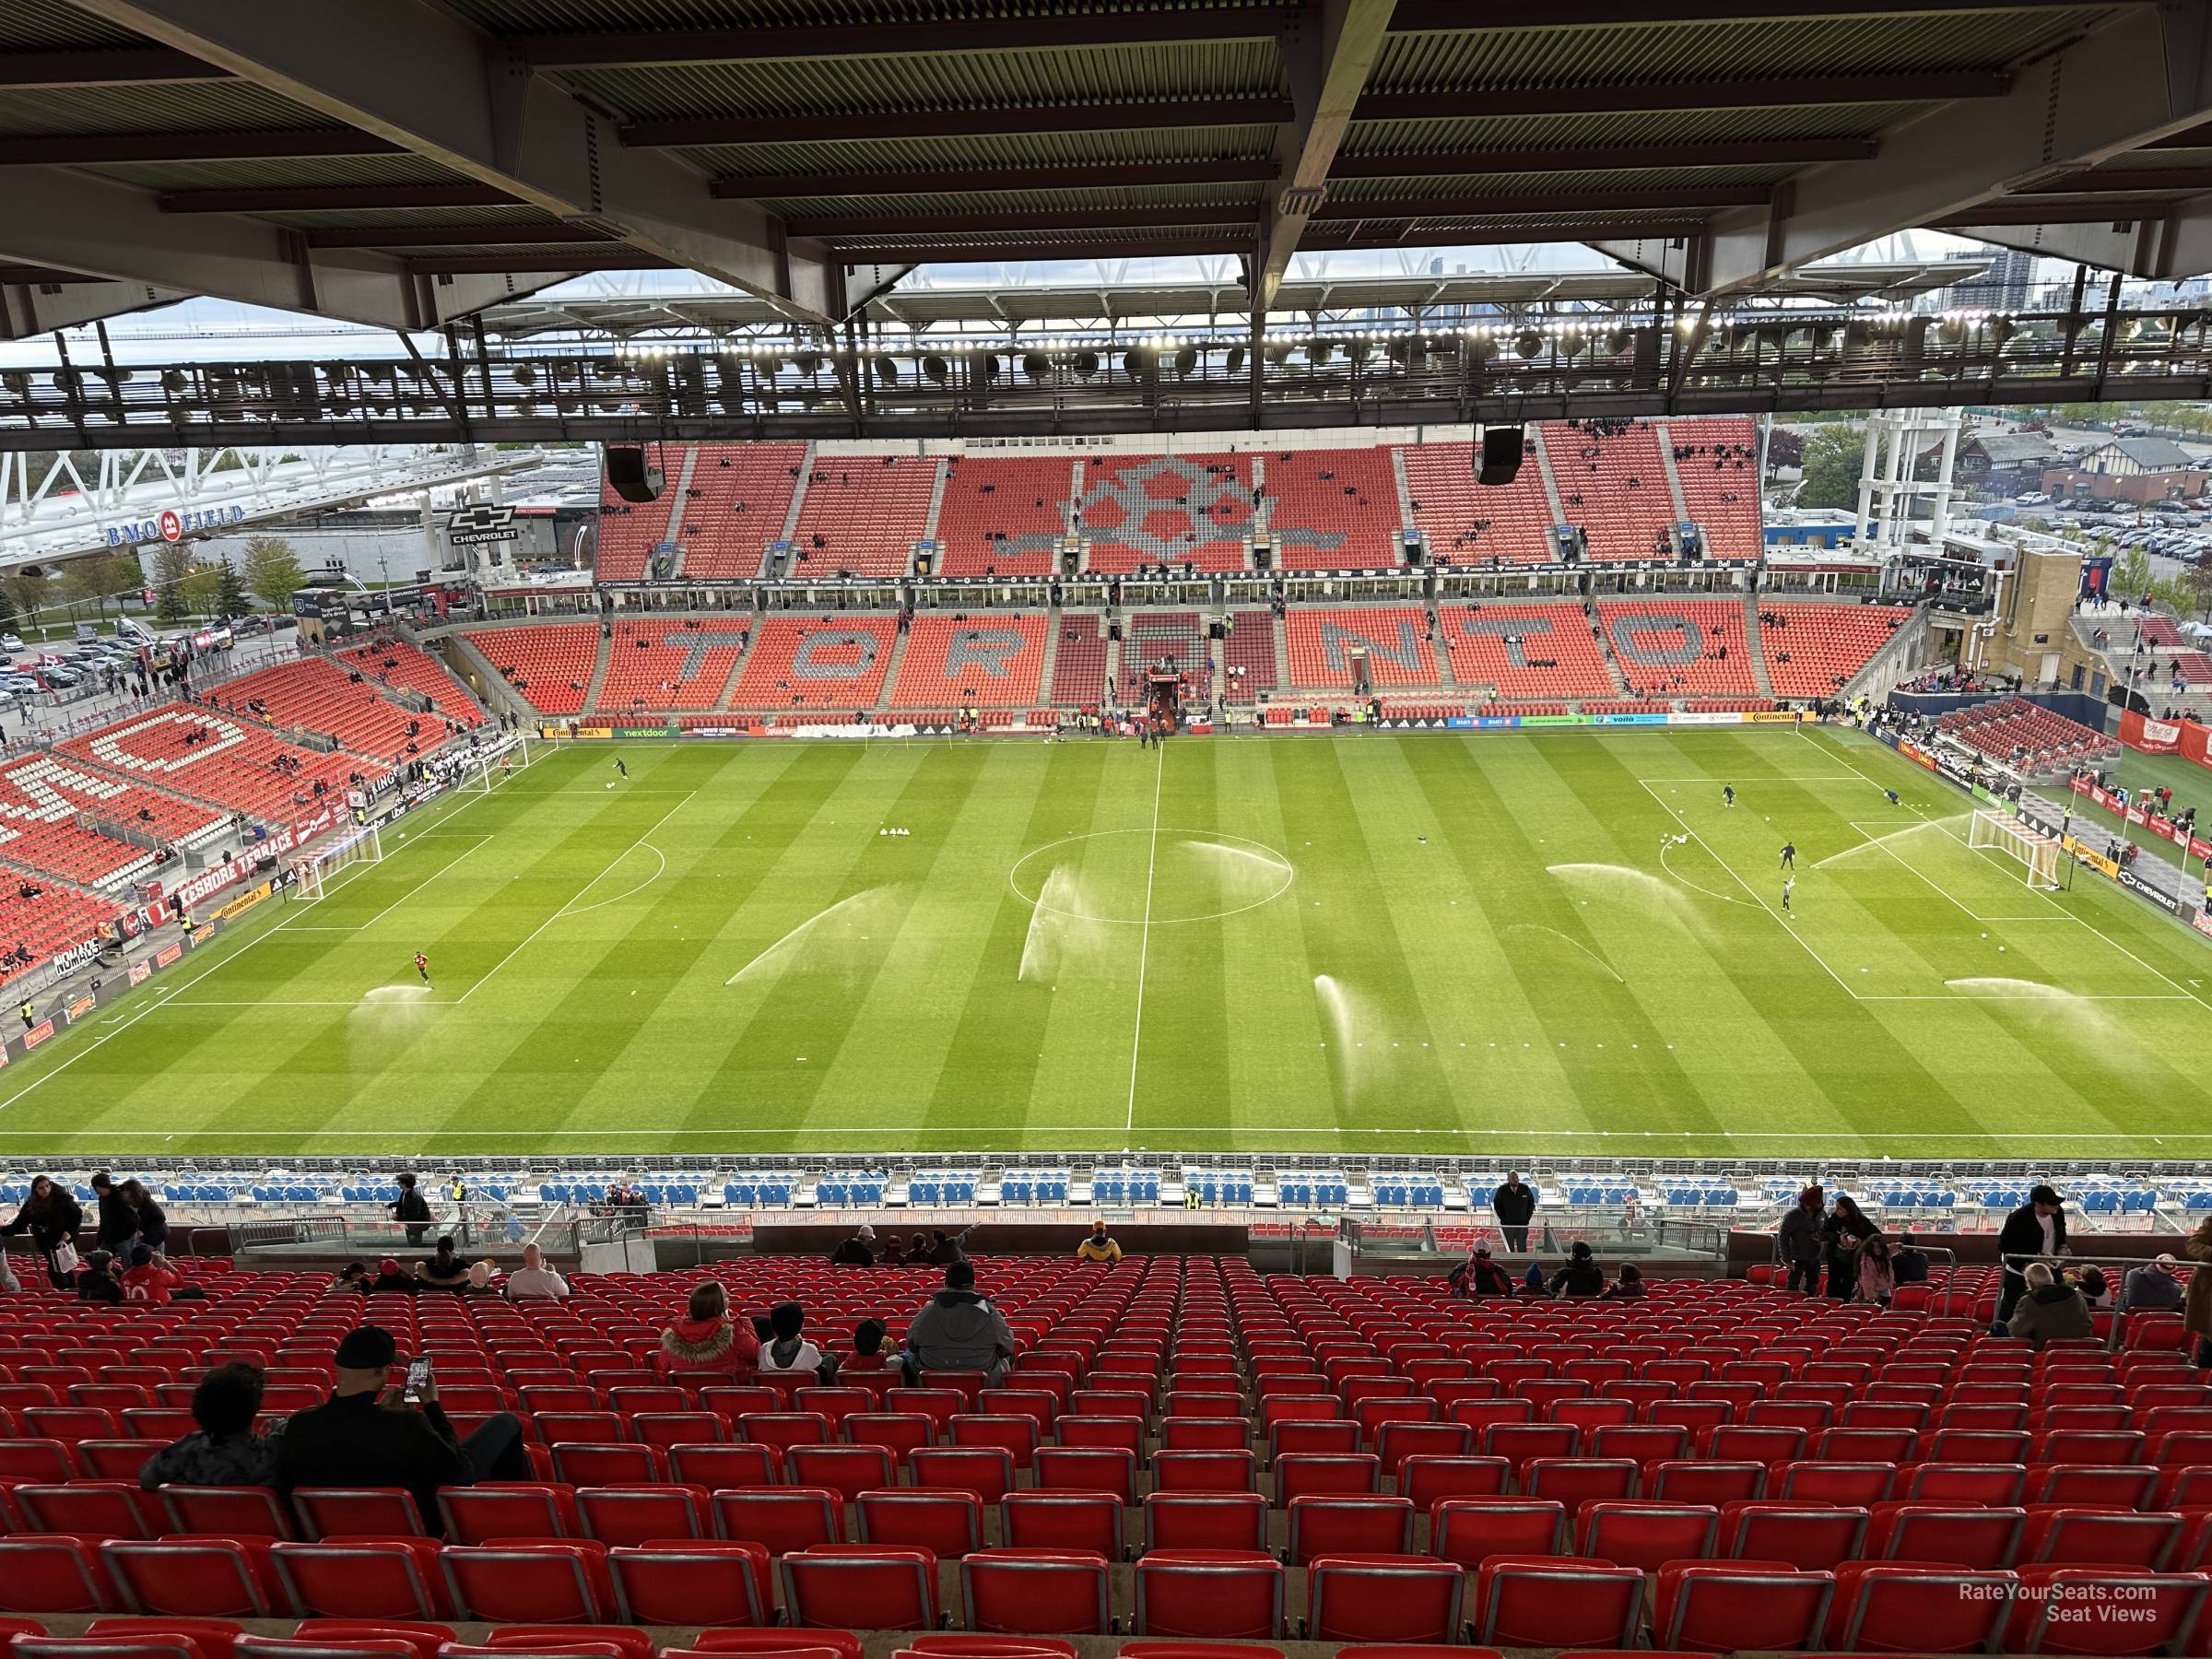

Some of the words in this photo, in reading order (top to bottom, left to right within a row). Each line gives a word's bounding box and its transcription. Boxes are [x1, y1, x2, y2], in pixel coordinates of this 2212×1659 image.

[107, 521, 157, 546] BMO
[182, 505, 243, 532] FIELD
[453, 531, 516, 544] CHEVROLET
[1753, 712, 1796, 722] Continental
[624, 728, 667, 736] nextdoor
[391, 806, 406, 819] Uber
[157, 862, 238, 922] LKESHORE
[2136, 882, 2177, 910] CHEVROLET
[221, 894, 257, 920] Continental
[53, 937, 101, 973] NOMADS
[27, 1026, 53, 1046] PRIMO
